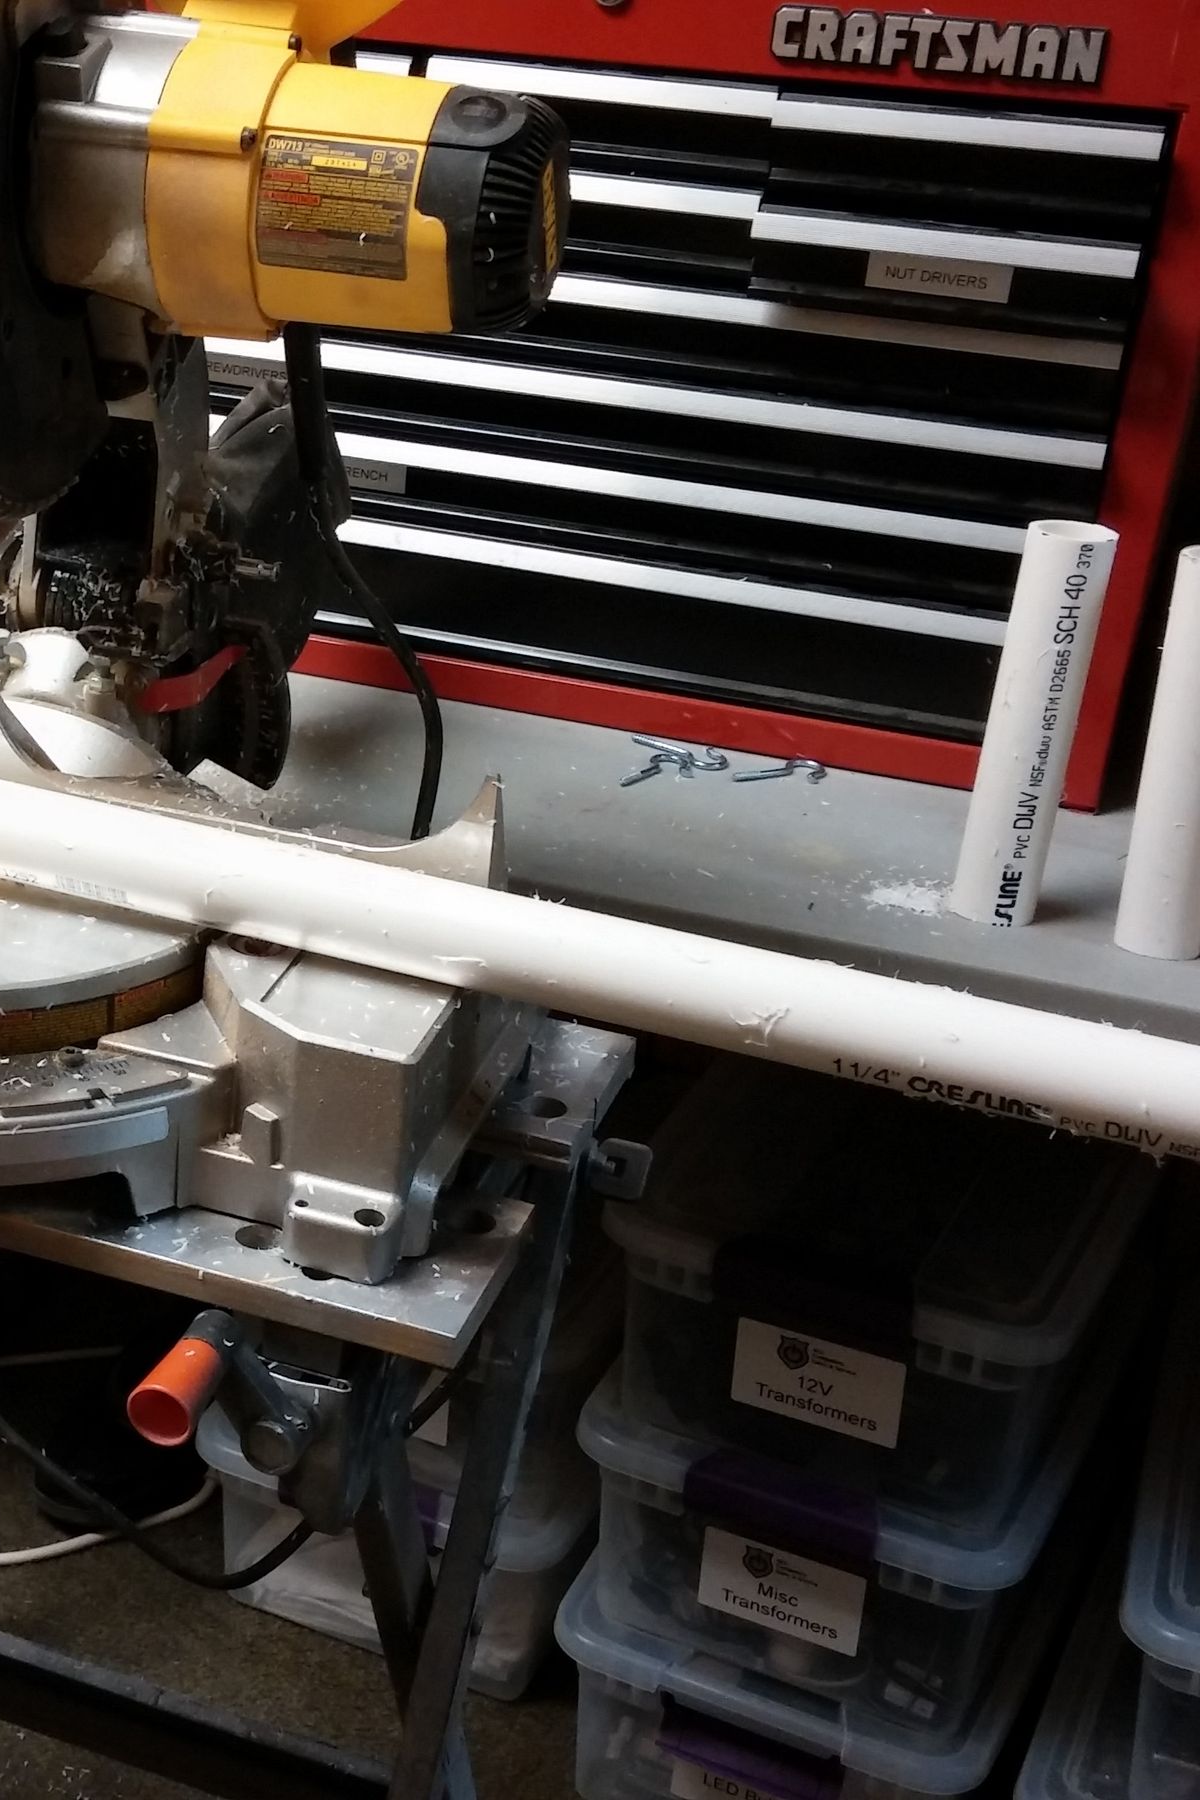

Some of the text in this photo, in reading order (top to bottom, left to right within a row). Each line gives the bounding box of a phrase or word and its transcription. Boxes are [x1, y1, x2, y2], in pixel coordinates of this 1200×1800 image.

[772, 4, 1110, 85] CRAFTSMAN
[268, 138, 304, 152] DW713
[885, 265, 988, 290] NUT DRIVERS
[207, 361, 288, 380] REWDRIVERS
[346, 466, 389, 483] RENCH
[1077, 544, 1095, 569] 370
[1064, 574, 1087, 600] 40
[1054, 606, 1081, 644] SCH
[1050, 650, 1071, 693] D2665
[1042, 697, 1060, 731] ASTM
[1013, 791, 1039, 830] DWV
[1013, 835, 1030, 859] PVC
[833, 1058, 842, 1073] 1
[1060, 1116, 1096, 1133] PVC
[1104, 1121, 1163, 1147] DWV
[798, 1376, 834, 1397] 12V
[756, 1382, 878, 1432] Transformers
[757, 1582, 800, 1607] Misc
[722, 1588, 839, 1640] Transformers
[703, 1773, 739, 1797] LED
